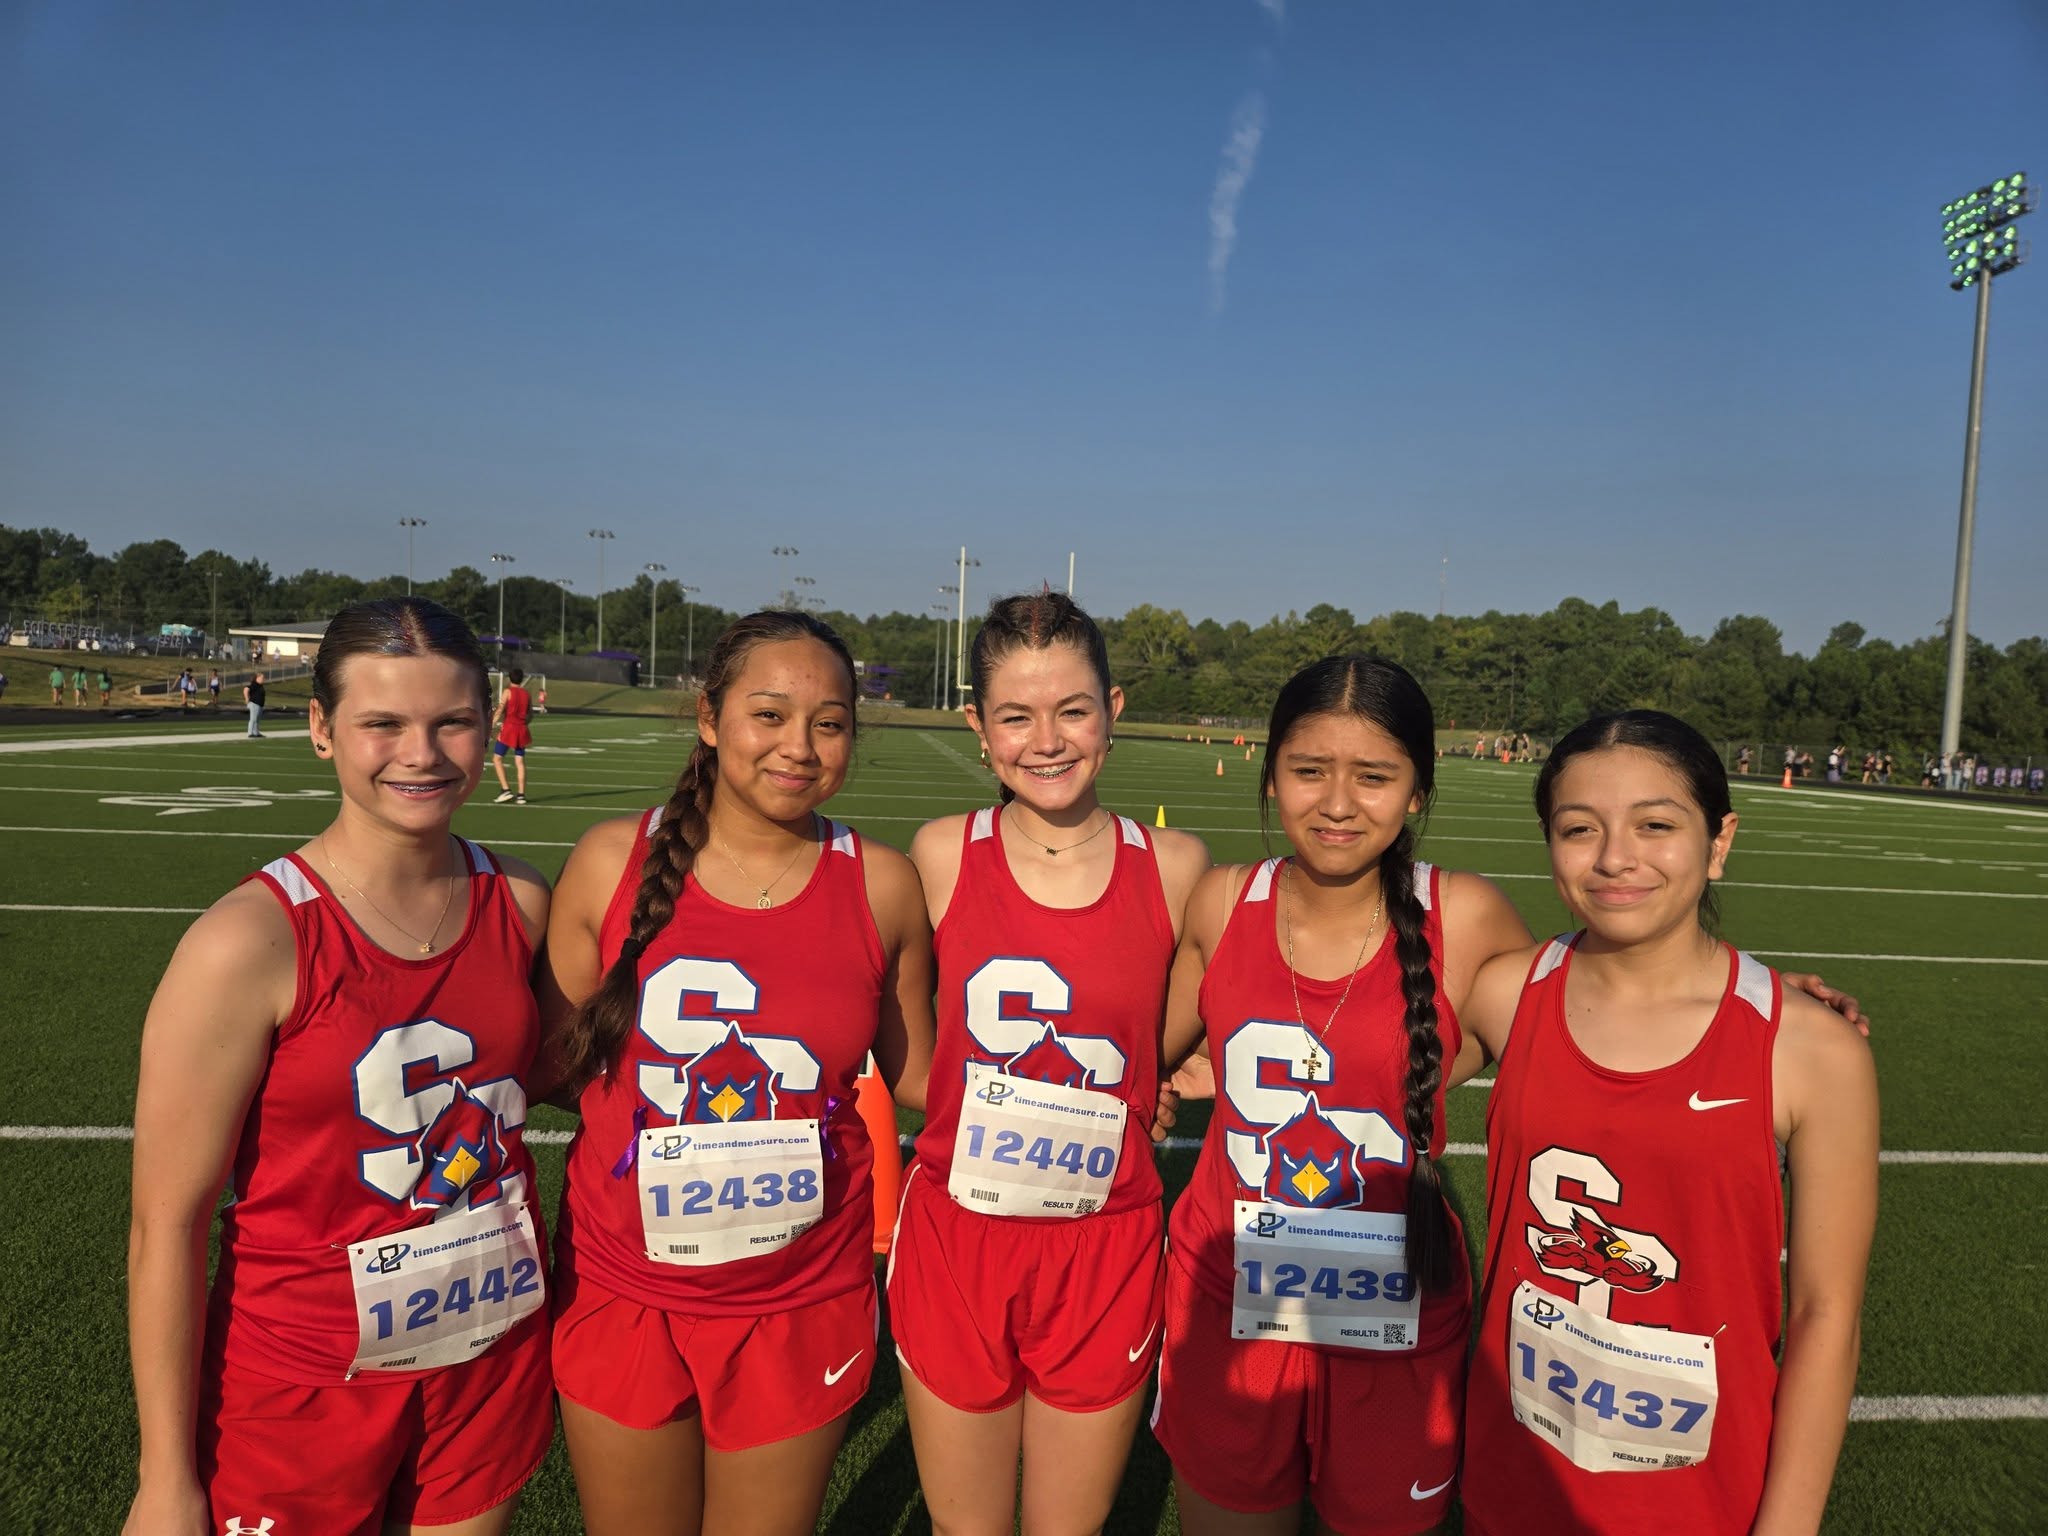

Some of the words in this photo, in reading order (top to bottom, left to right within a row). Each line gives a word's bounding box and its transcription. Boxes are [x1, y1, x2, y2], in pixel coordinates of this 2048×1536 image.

[1014, 1096, 1119, 1122] timeandmeasure.com
[692, 1135, 810, 1152] timeandmeasure.com
[966, 1124, 1116, 1179] 12440
[647, 1167, 819, 1218] 12438
[1041, 1199, 1075, 1210] RESULTS
[412, 1219, 524, 1260] timeandmeasure.com
[749, 1232, 788, 1246] RESULTS
[368, 1255, 540, 1341] 12442
[1240, 1259, 1416, 1303] 12439
[1340, 1327, 1380, 1339] RESULTS
[1564, 1321, 1704, 1370] timeandmeasure.com
[1515, 1341, 1709, 1435] 12437
[1611, 1450, 1659, 1465] RESULTS
